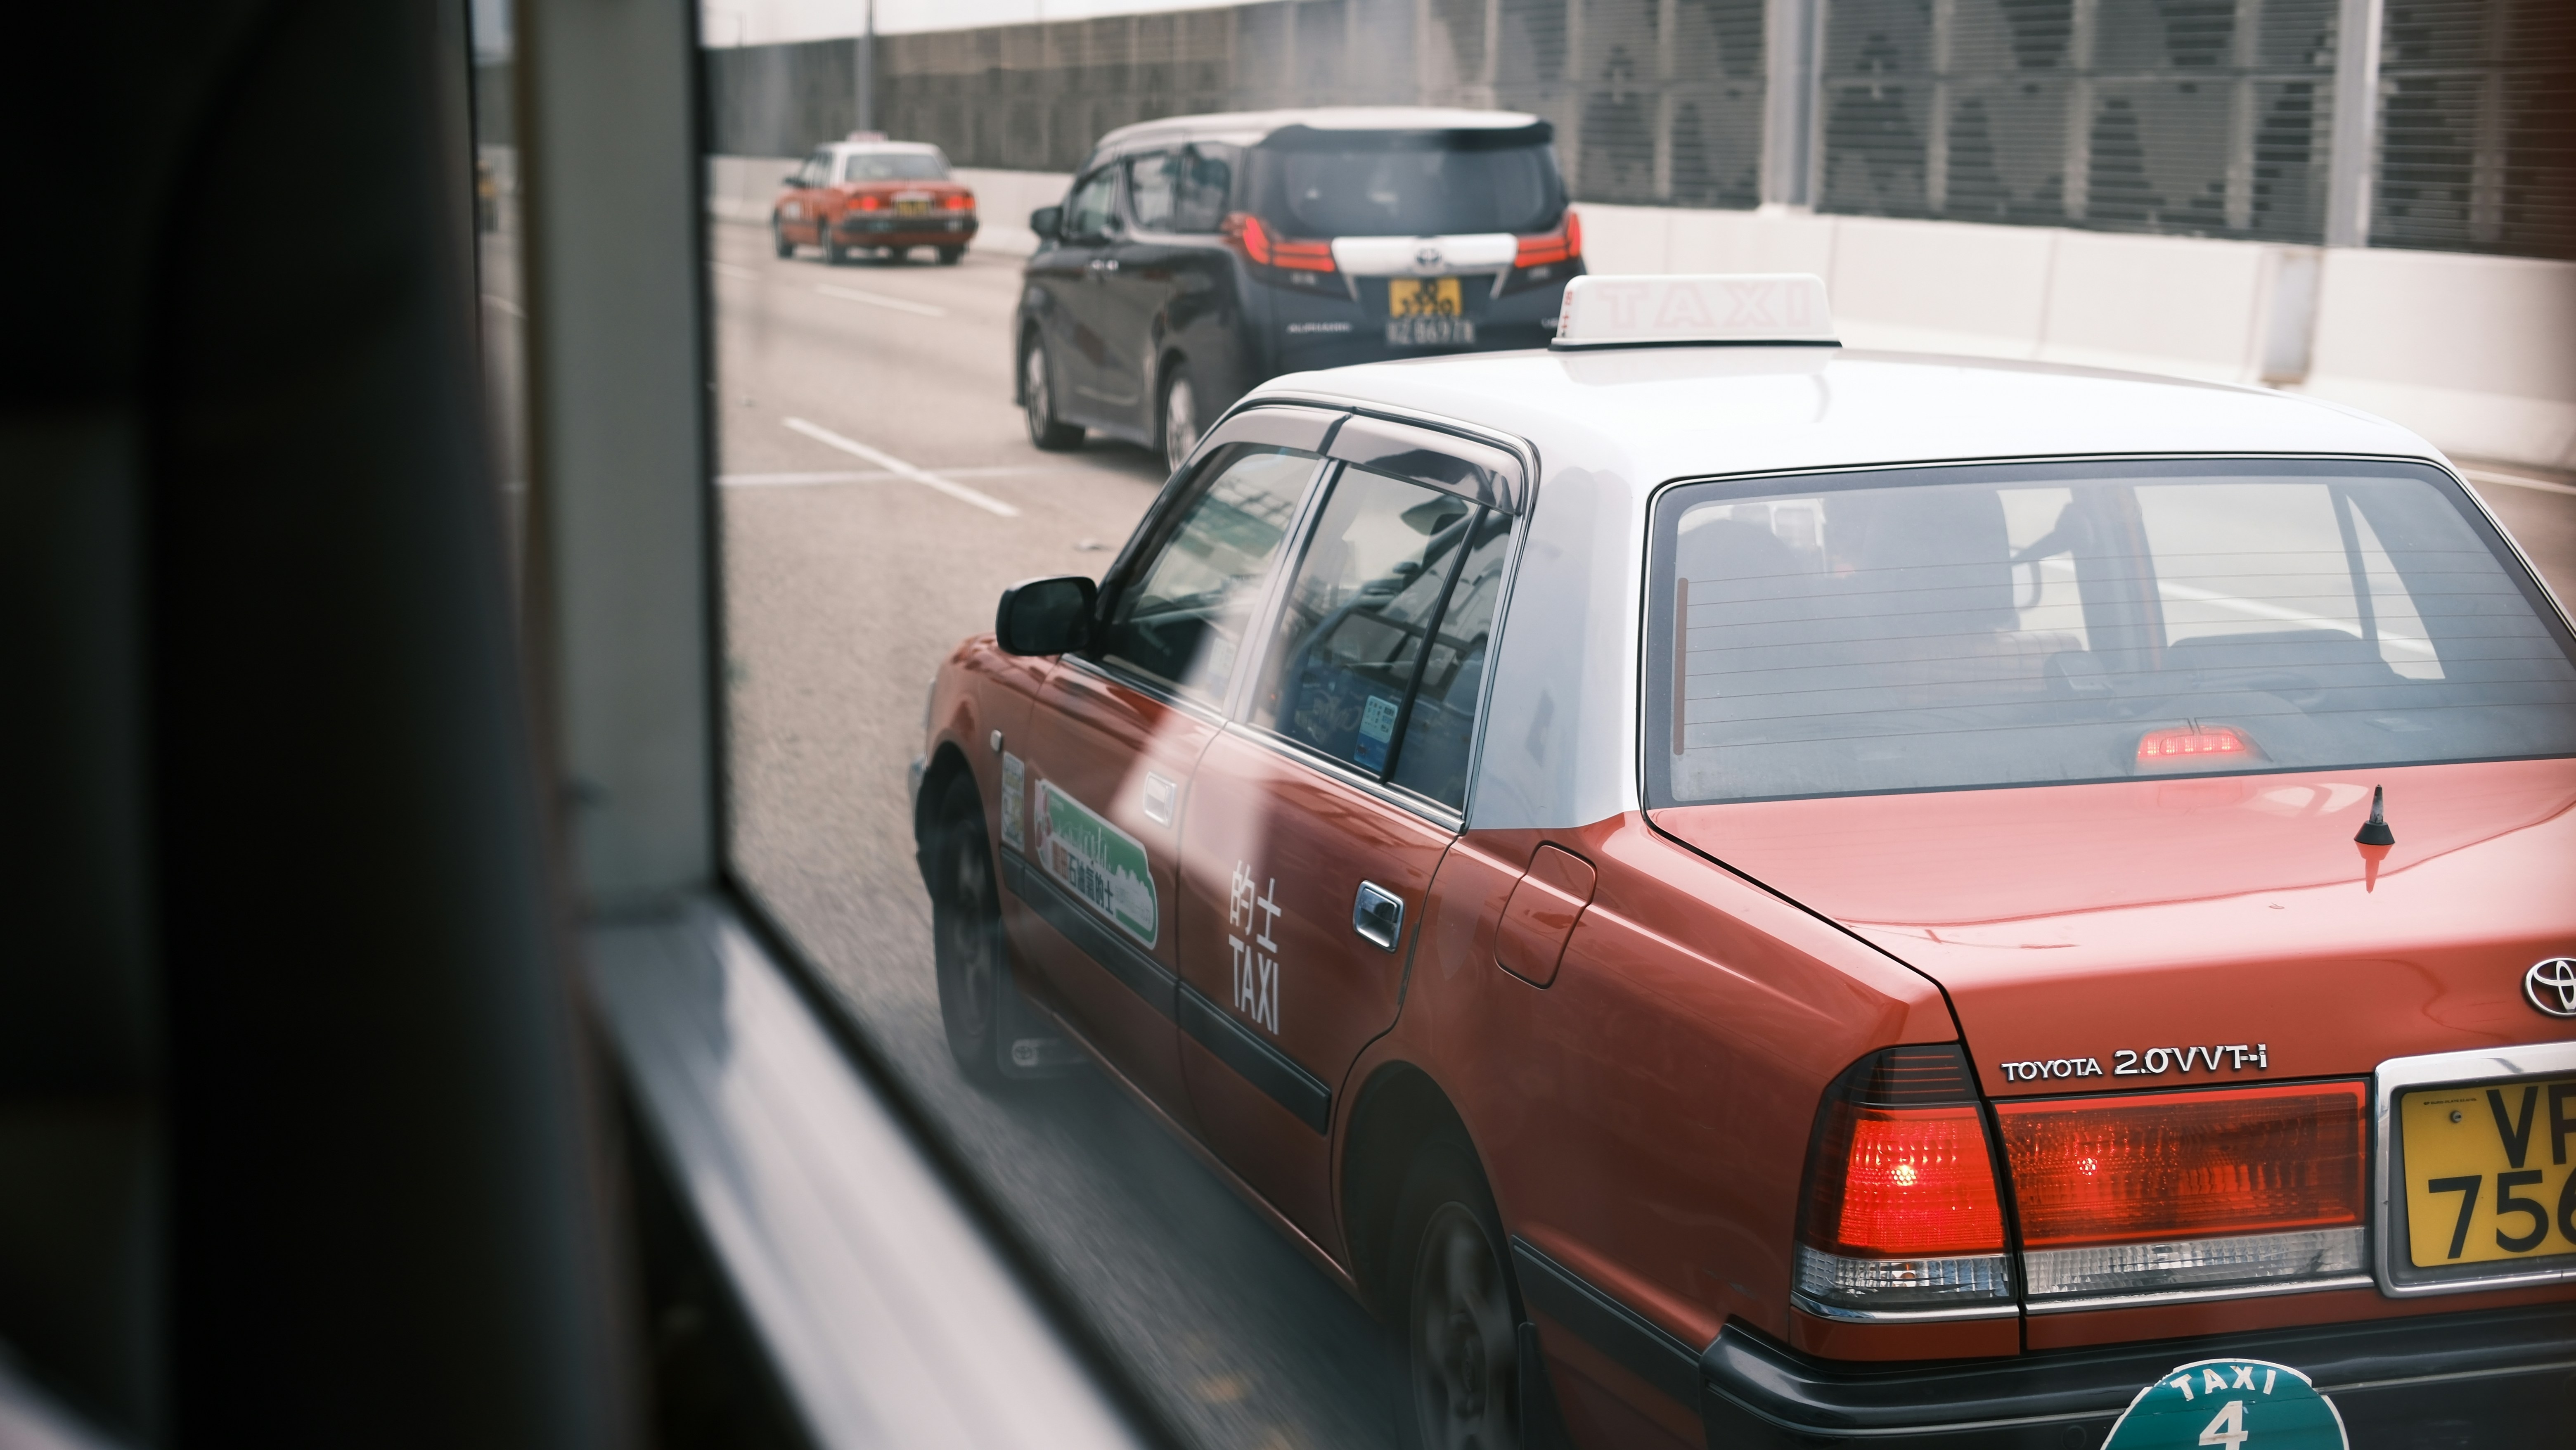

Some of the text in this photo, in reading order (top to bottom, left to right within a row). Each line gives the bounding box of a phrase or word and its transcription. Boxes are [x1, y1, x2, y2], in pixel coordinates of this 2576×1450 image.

[1594, 282, 1811, 330] TAXI
[1229, 860, 1281, 954] 的士
[1229, 933, 1279, 1035] TAXI
[2001, 1058, 2103, 1081] TOYOTA
[2169, 1365, 2276, 1401] TAXI
[2198, 1400, 2248, 1450] 4
